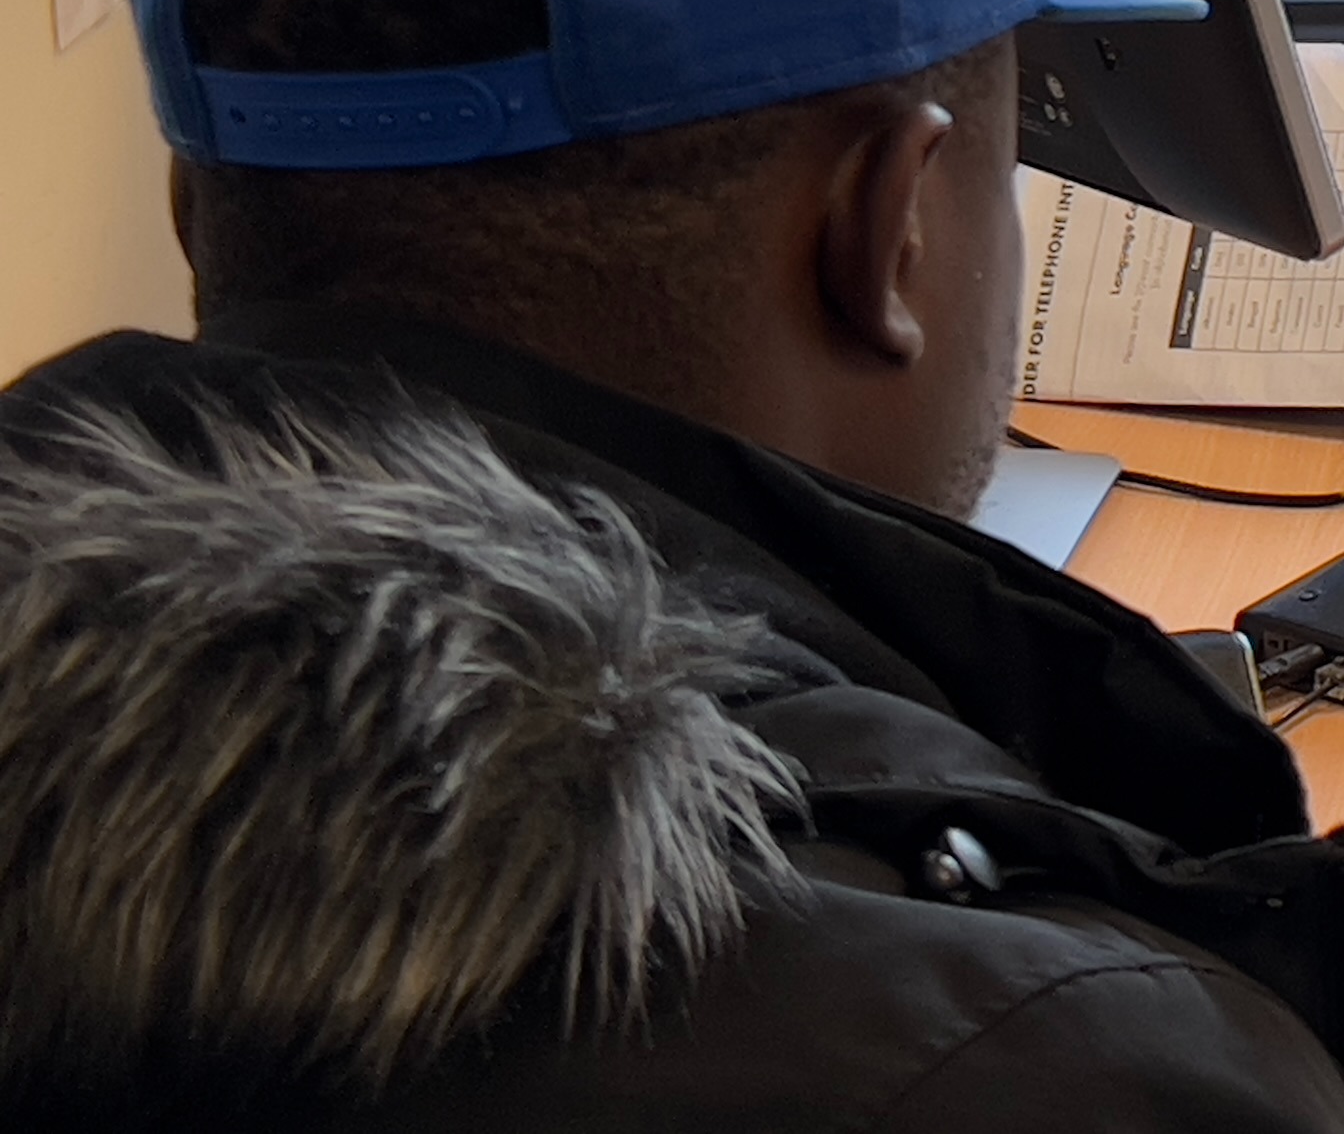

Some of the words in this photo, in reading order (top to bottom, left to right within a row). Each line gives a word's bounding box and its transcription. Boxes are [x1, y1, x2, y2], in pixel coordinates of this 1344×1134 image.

[1034, 216, 1068, 315] TELEPHONE
[1108, 224, 1136, 296] Language
[1027, 320, 1048, 355] FOR
